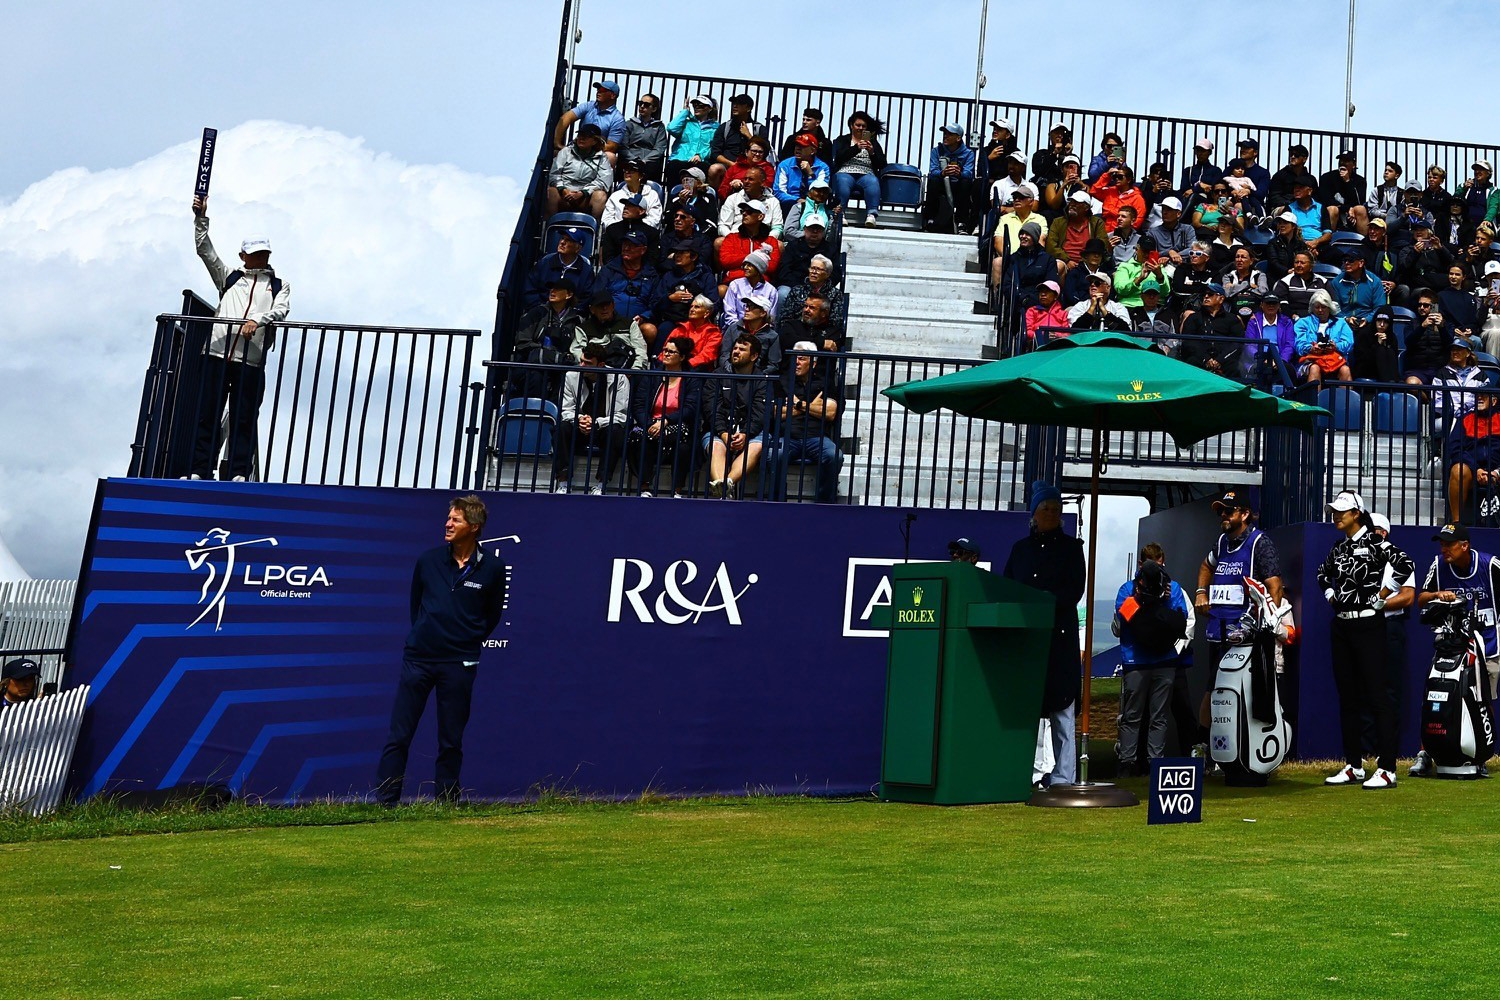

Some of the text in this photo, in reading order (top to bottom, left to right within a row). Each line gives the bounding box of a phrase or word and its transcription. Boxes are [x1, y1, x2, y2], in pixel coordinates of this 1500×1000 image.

[1116, 392, 1162, 402] ROLEX
[244, 564, 331, 587] LPGA
[260, 589, 312, 599] Official Event
[607, 558, 759, 625] R&A
[1211, 589, 1231, 600] MAL
[898, 609, 936, 623] ROLEX
[482, 639, 508, 649] VENT
[1162, 771, 1191, 786] AIG
